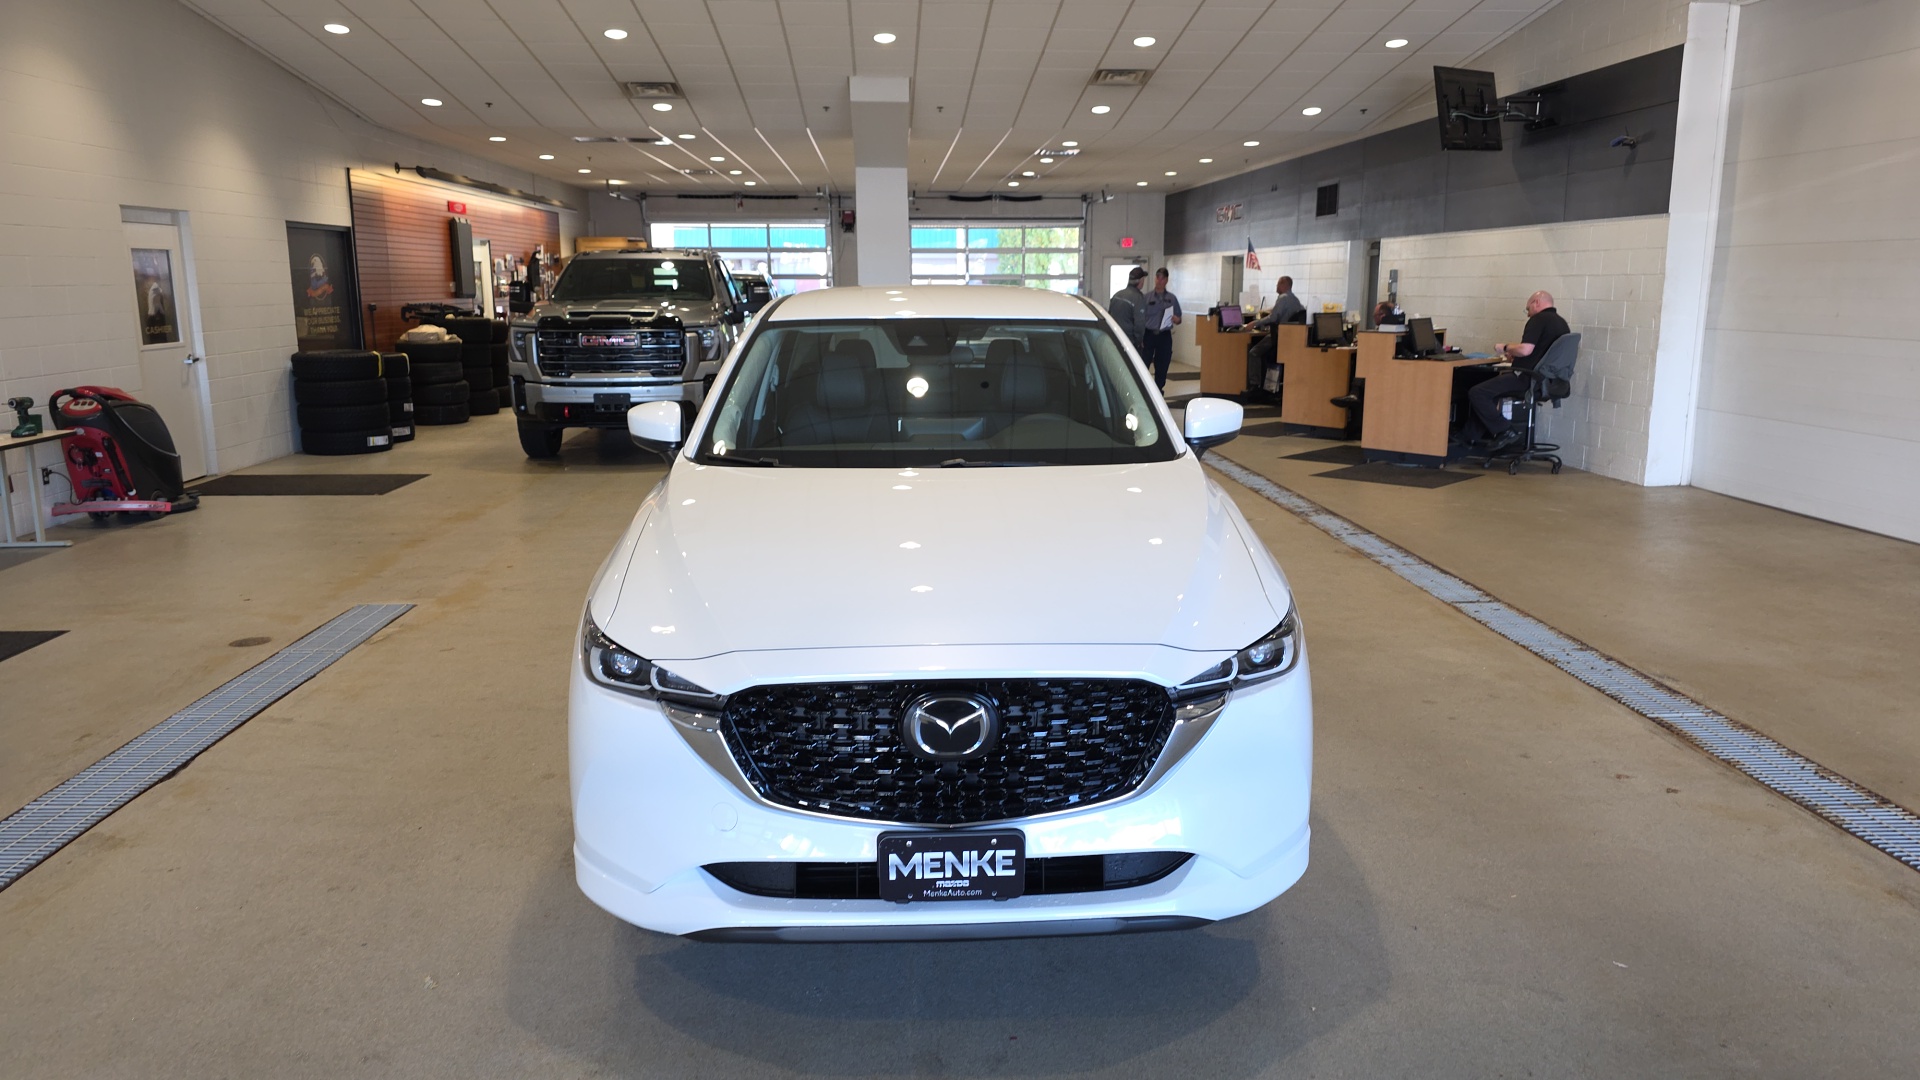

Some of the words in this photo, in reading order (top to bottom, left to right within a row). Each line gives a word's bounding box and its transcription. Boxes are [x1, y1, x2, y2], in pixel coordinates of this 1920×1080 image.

[312, 306, 340, 315] APPRECIATE
[145, 325, 172, 335] CASHIER
[310, 326, 326, 335] THANK
[583, 335, 635, 346] GMC
[888, 849, 1016, 881] MENKE
[923, 888, 983, 897] MenkeAuto.com
